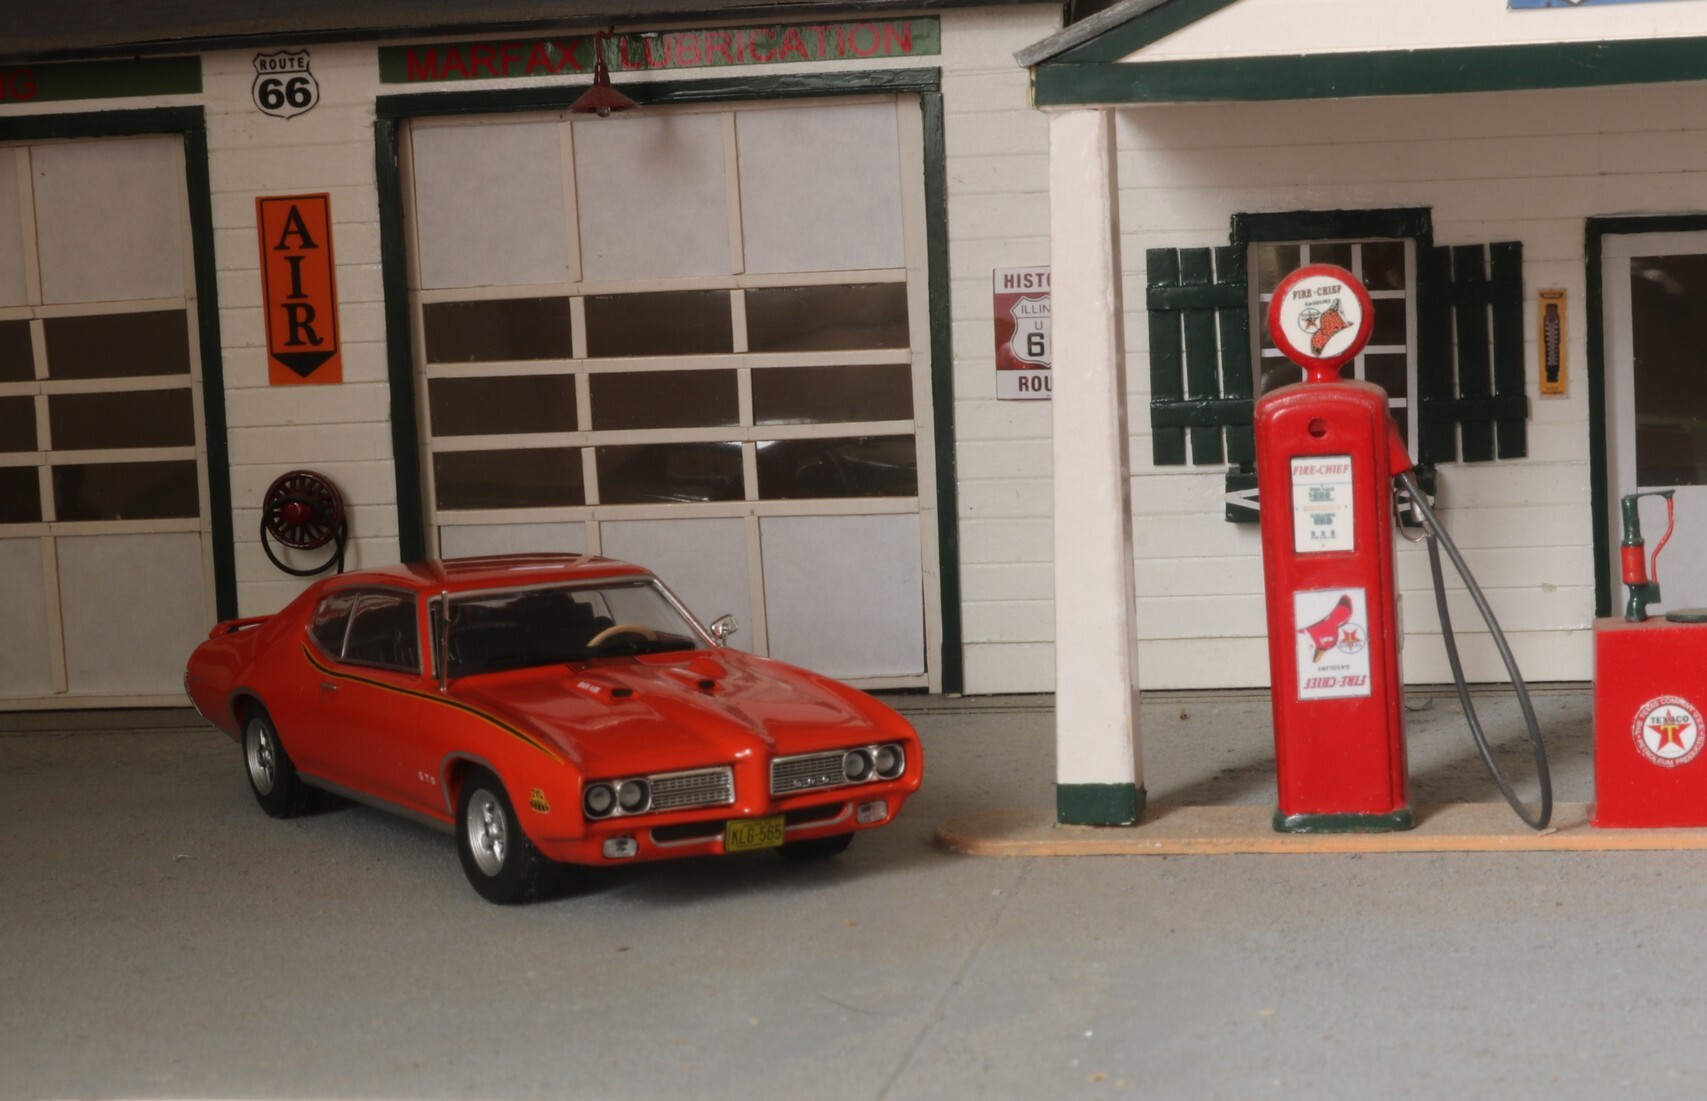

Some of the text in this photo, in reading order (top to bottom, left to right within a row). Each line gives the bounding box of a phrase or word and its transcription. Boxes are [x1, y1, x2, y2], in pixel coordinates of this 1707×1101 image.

[407, 22, 913, 81] MARFAX LUBRICATION
[260, 57, 305, 71] ROUTE
[0, 68, 37, 100] G
[259, 77, 312, 110] 66
[273, 204, 324, 346] AIR
[1027, 332, 1051, 357] 6
[1293, 464, 1349, 475] FIRE-CHIEF
[1318, 664, 1350, 672] GASOLINE
[1304, 675, 1366, 689] FIRE-CHIEF
[1650, 715, 1689, 724] TEXACO
[418, 772, 436, 785] GTO
[731, 824, 782, 845] KLG-565
